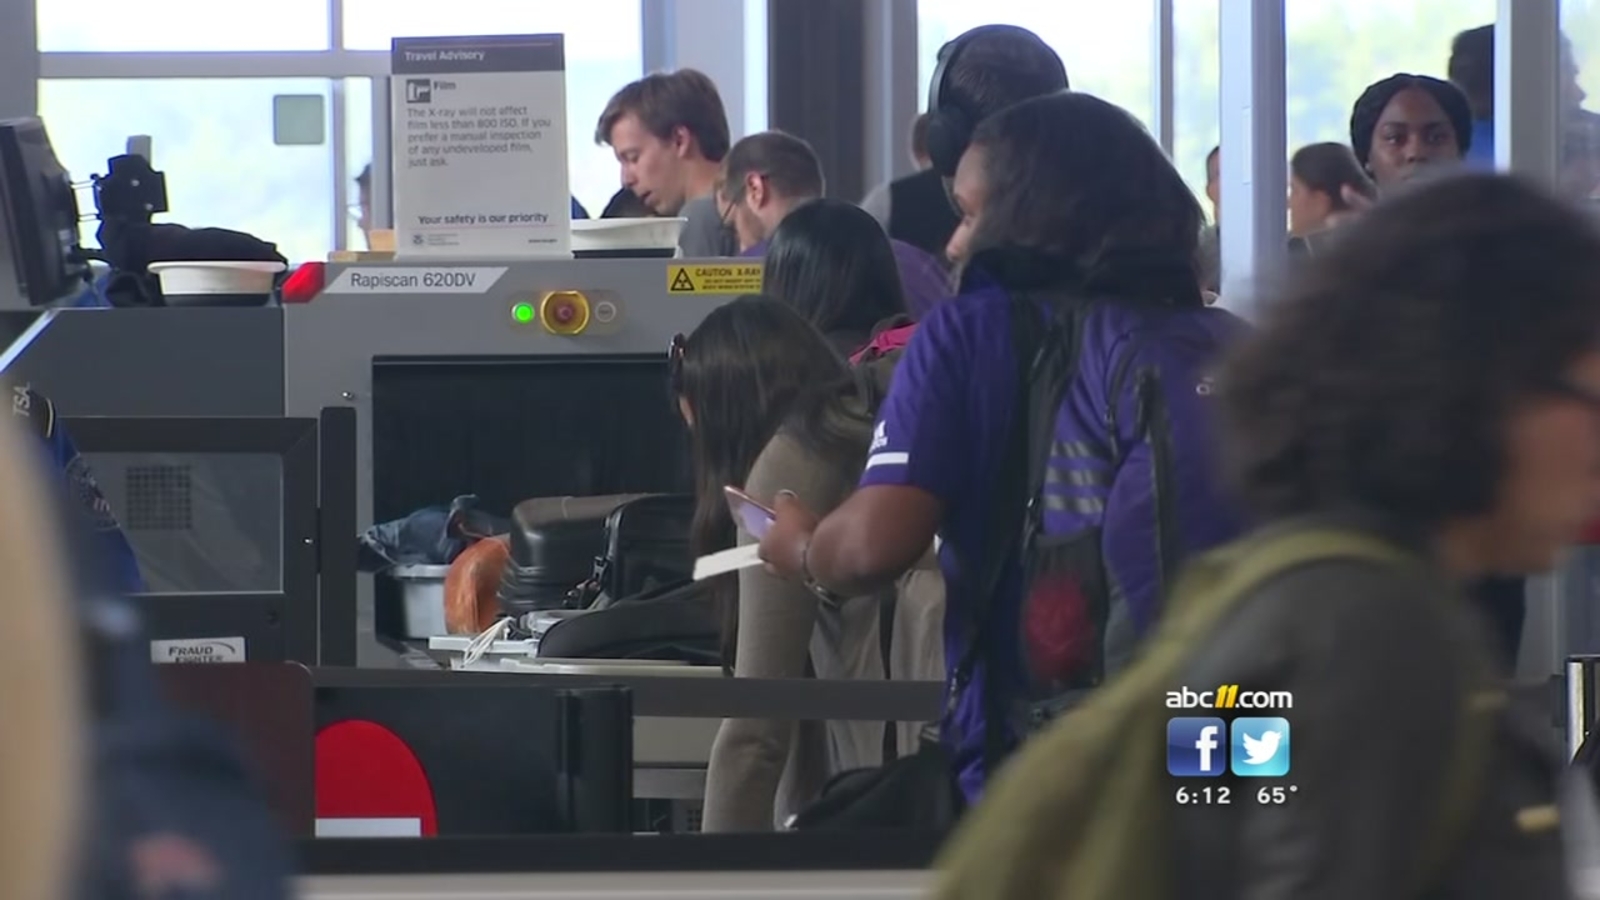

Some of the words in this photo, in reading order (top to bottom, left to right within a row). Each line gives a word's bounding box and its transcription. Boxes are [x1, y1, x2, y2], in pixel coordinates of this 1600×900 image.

[405, 51, 437, 61] Travel
[439, 50, 485, 61] Advisory
[433, 81, 457, 91] Film
[407, 108, 425, 118] The
[428, 108, 455, 119] X-ray
[459, 107, 478, 117] will
[480, 106, 497, 117] not
[499, 105, 528, 116] affect
[407, 120, 428, 131] film
[430, 120, 450, 130] less
[451, 120, 475, 130] than
[477, 119, 497, 129] 800
[521, 118, 530, 128] If
[532, 119, 551, 130] you
[408, 132, 439, 145] prefer
[450, 131, 488, 142] manual
[490, 130, 541, 143] inspection
[408, 145, 419, 155] of
[421, 146, 441, 157] any
[443, 143, 509, 155] undeveloped
[510, 142, 533, 153] film,
[407, 157, 428, 169] just
[429, 156, 448, 167] ask.
[418, 215, 442, 225] Your
[444, 214, 475, 226] safety
[478, 214, 487, 223] is
[489, 214, 506, 223] our
[508, 212, 548, 224] priority
[695, 268, 732, 276] CAUTION
[350, 272, 418, 290] Rapiscan
[422, 272, 476, 288] 620DV
[13, 382, 31, 417] TSA
[168, 646, 214, 657] FRAUD
